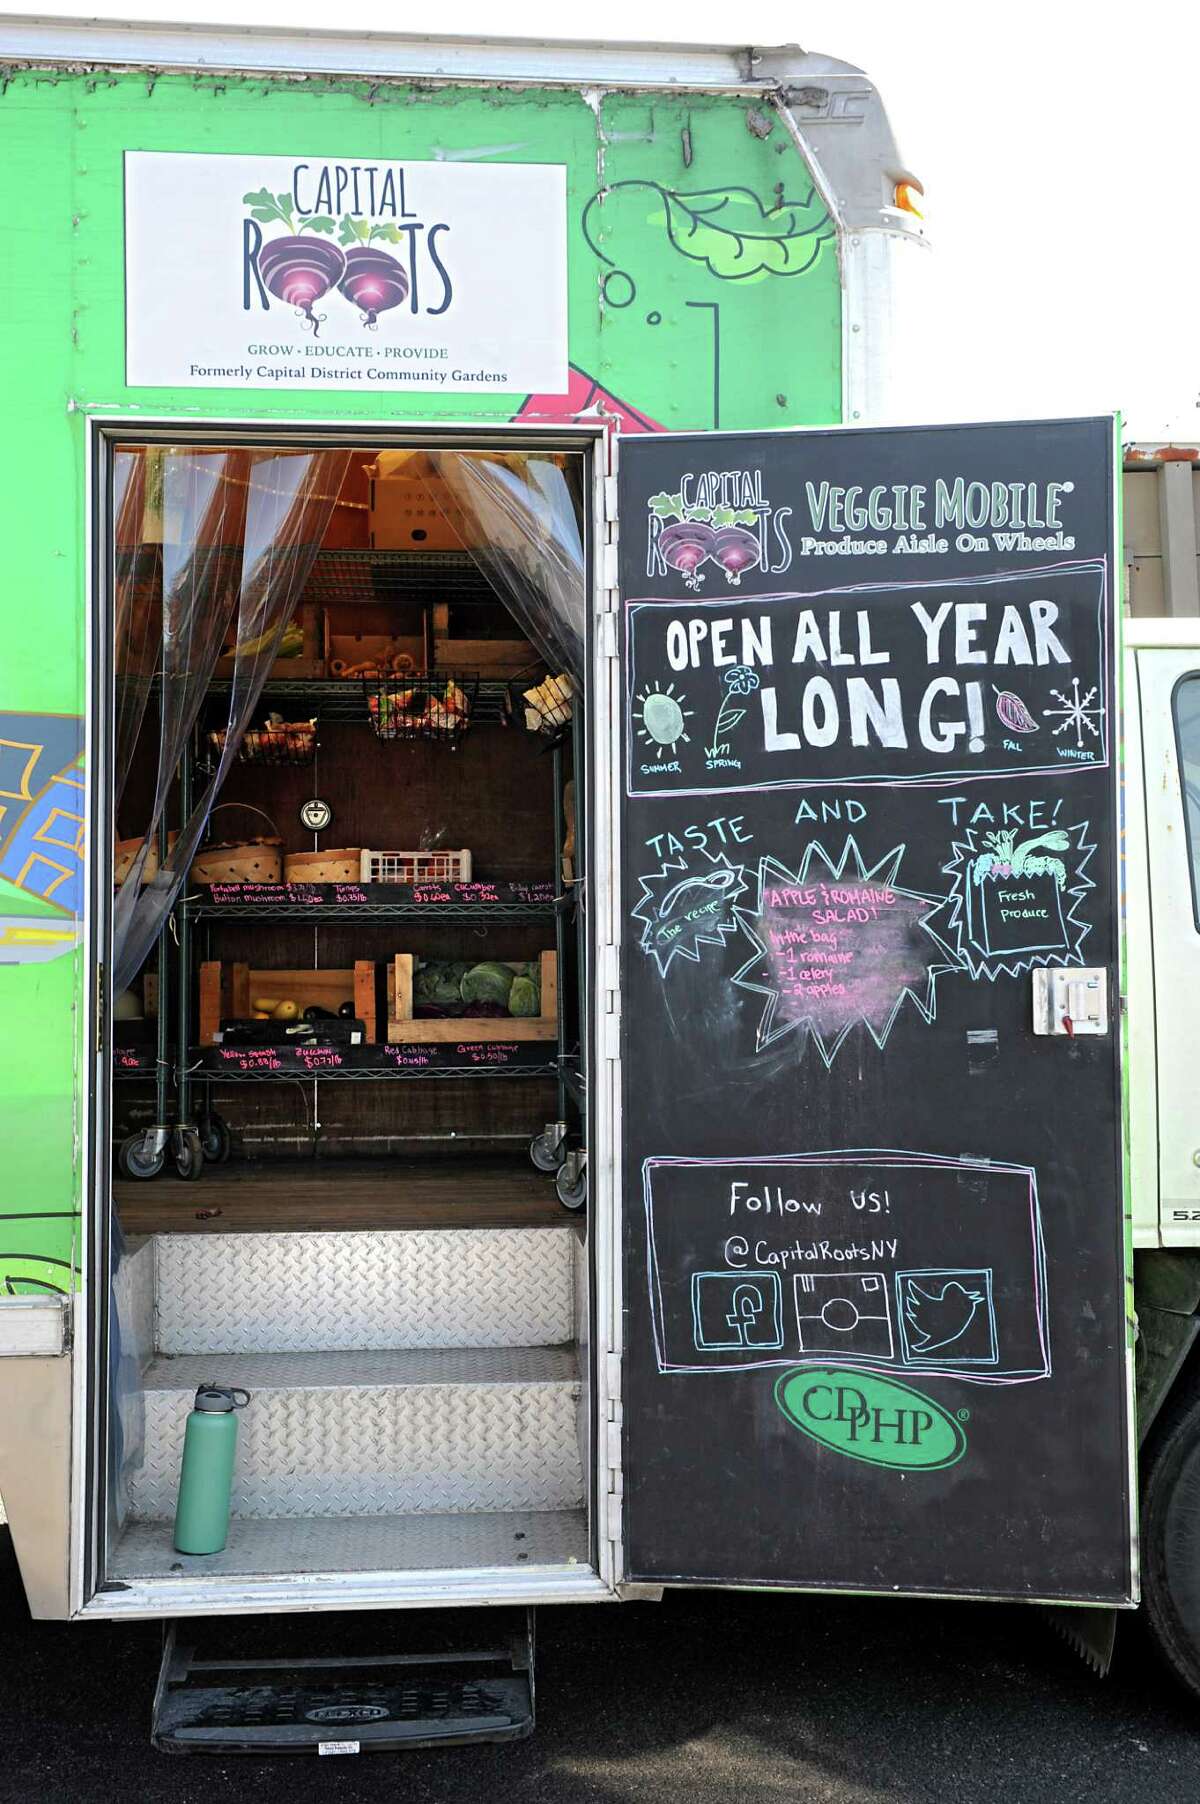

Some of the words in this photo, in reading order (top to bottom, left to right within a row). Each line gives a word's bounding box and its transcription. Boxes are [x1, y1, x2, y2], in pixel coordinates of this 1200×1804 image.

[294, 164, 416, 217] CAPITAL
[247, 344, 294, 357] GROW
[305, 346, 374, 358] EDUCATE
[384, 347, 449, 360] PROVIDE
[190, 364, 253, 380] Formerly
[256, 366, 306, 381] Capital
[310, 367, 362, 380] District
[366, 368, 448, 383] Community
[451, 370, 508, 383] Gardens
[680, 469, 770, 507] CAPITAL
[805, 481, 927, 533] VEGGIE
[800, 536, 888, 556] Produce
[893, 534, 949, 554] Aisle
[956, 534, 986, 553] On
[992, 531, 1076, 553] Wheels
[665, 615, 774, 672] OPEN
[791, 609, 891, 667] ALL
[910, 600, 1072, 667] YEAR
[760, 675, 987, 754] LONG!
[1003, 739, 1023, 752] FALL
[1056, 747, 1096, 761] WINTER
[640, 762, 682, 774] SUMMER
[704, 758, 742, 770] SPRING
[645, 815, 754, 857] TASTE
[795, 799, 868, 824] AND
[937, 797, 1064, 829] TAKE!
[770, 887, 816, 907] APPLE
[831, 885, 896, 905] ROMAINE
[998, 889, 1036, 903] Fresh
[660, 924, 683, 940] The
[684, 900, 721, 921] recipe
[800, 951, 853, 964] romaine
[729, 1182, 822, 1216] Follow
[724, 1235, 898, 1269] @CapitalRootsNY
[803, 1386, 933, 1446] CDPHP
